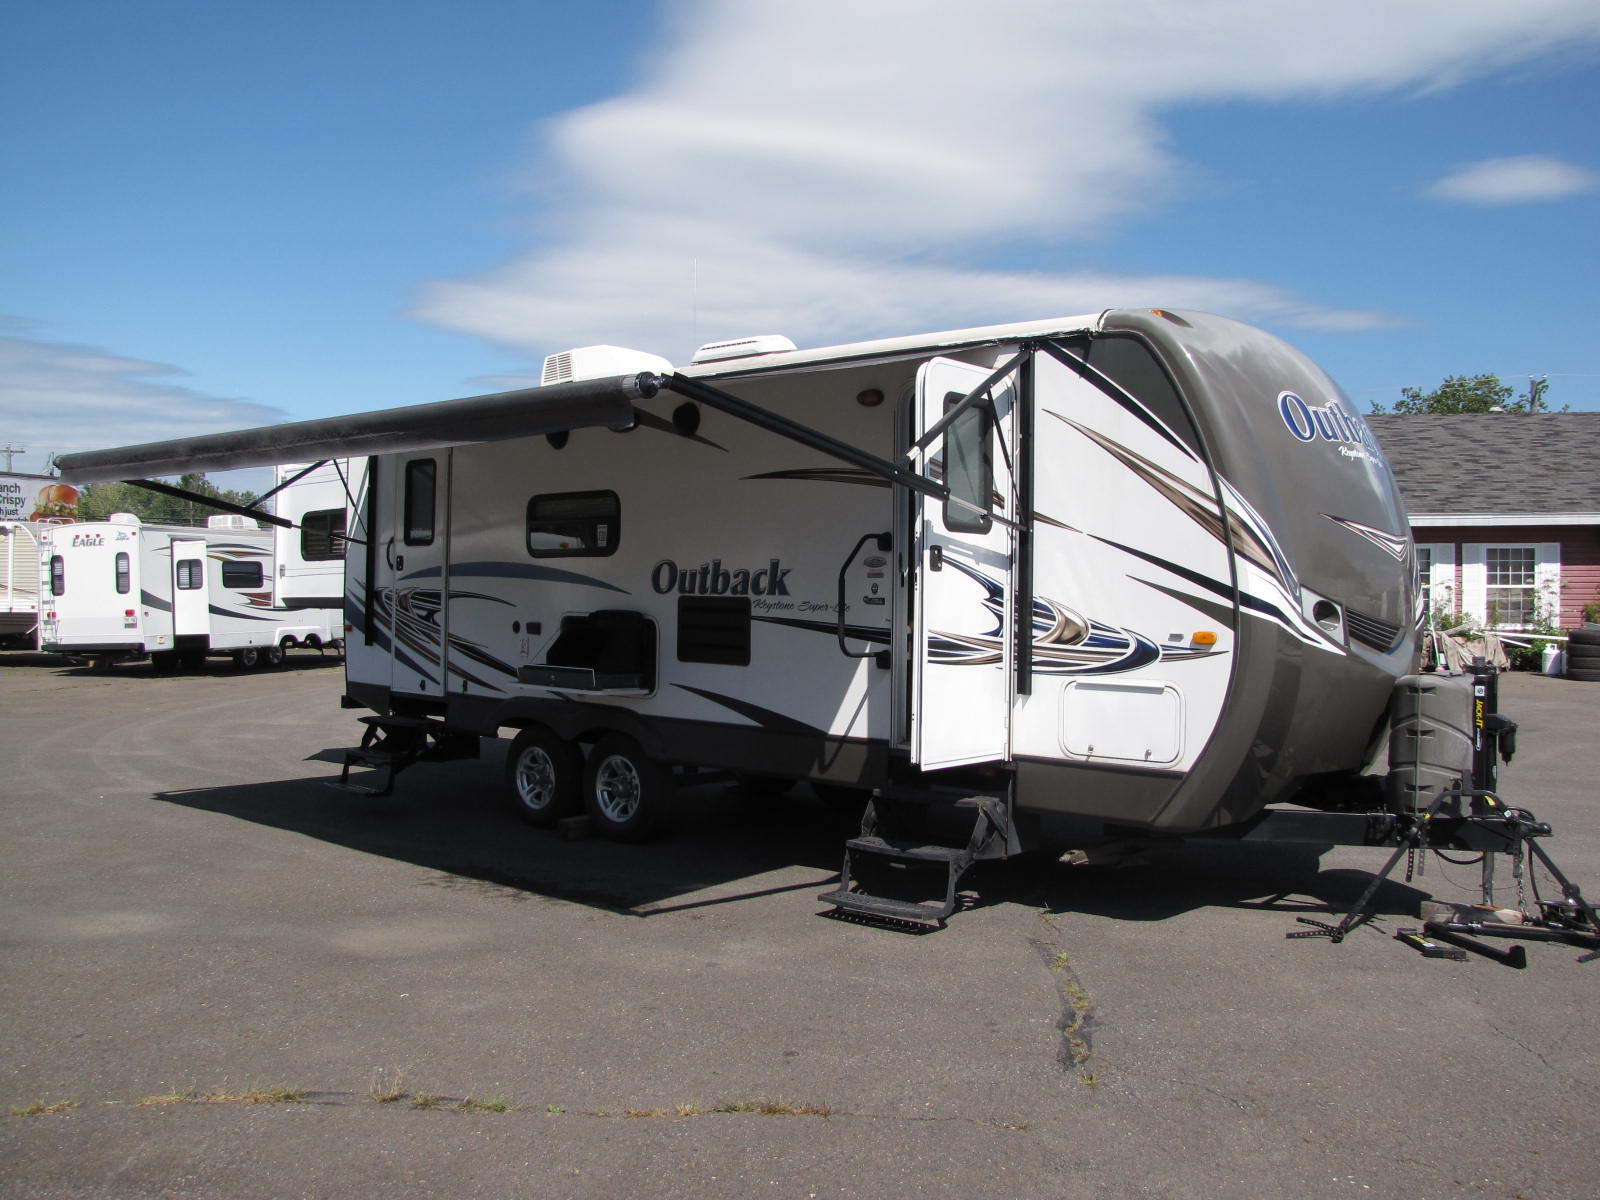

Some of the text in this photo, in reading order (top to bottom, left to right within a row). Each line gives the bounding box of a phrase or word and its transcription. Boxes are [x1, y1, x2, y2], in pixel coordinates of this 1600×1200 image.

[72, 537, 105, 547] EAGLE
[651, 558, 793, 596] Outback
[752, 598, 851, 614] Keystone Super-Le
